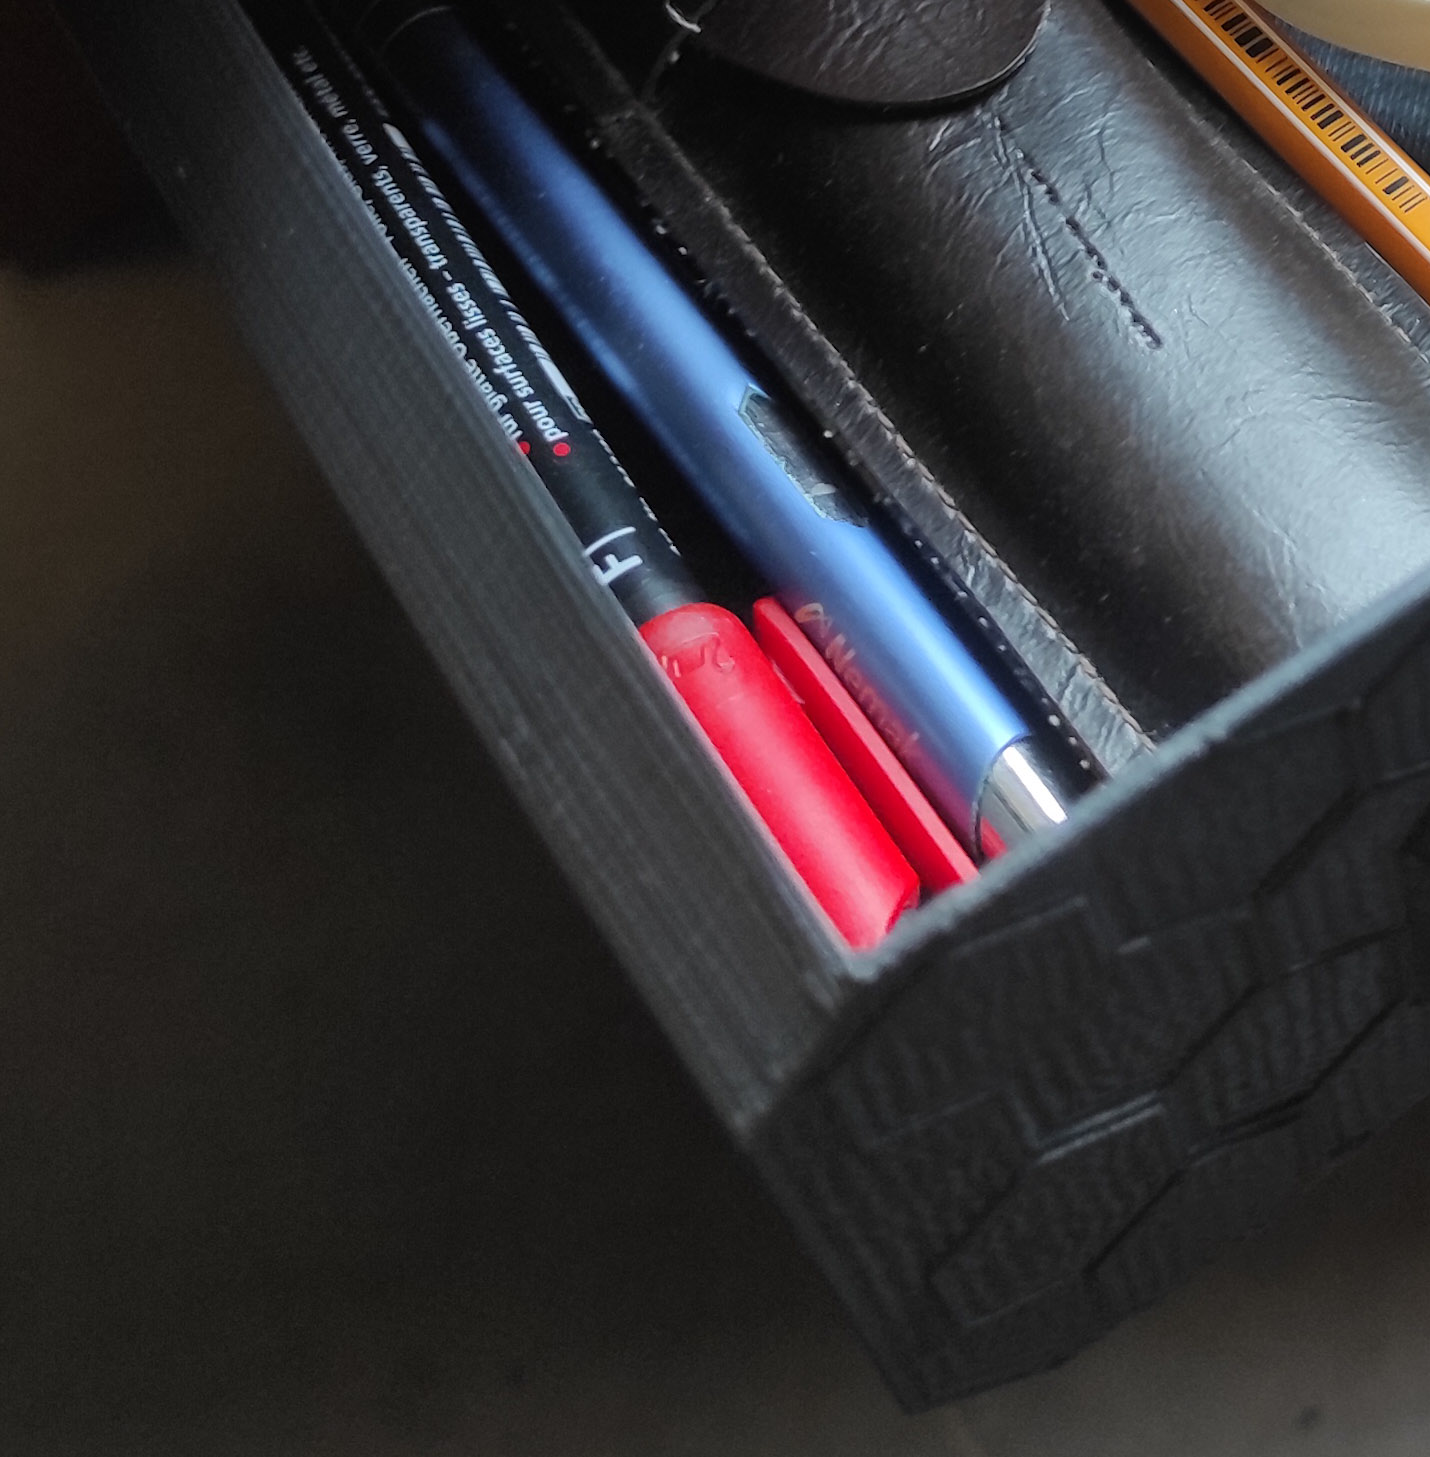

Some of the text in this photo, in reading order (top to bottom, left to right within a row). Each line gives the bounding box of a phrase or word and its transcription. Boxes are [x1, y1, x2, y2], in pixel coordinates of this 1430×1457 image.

[341, 117, 379, 167] verre,
[372, 164, 449, 270] transparents,
[445, 282, 489, 331] lisses
[475, 328, 535, 399] surfaces
[523, 400, 570, 442] pour
